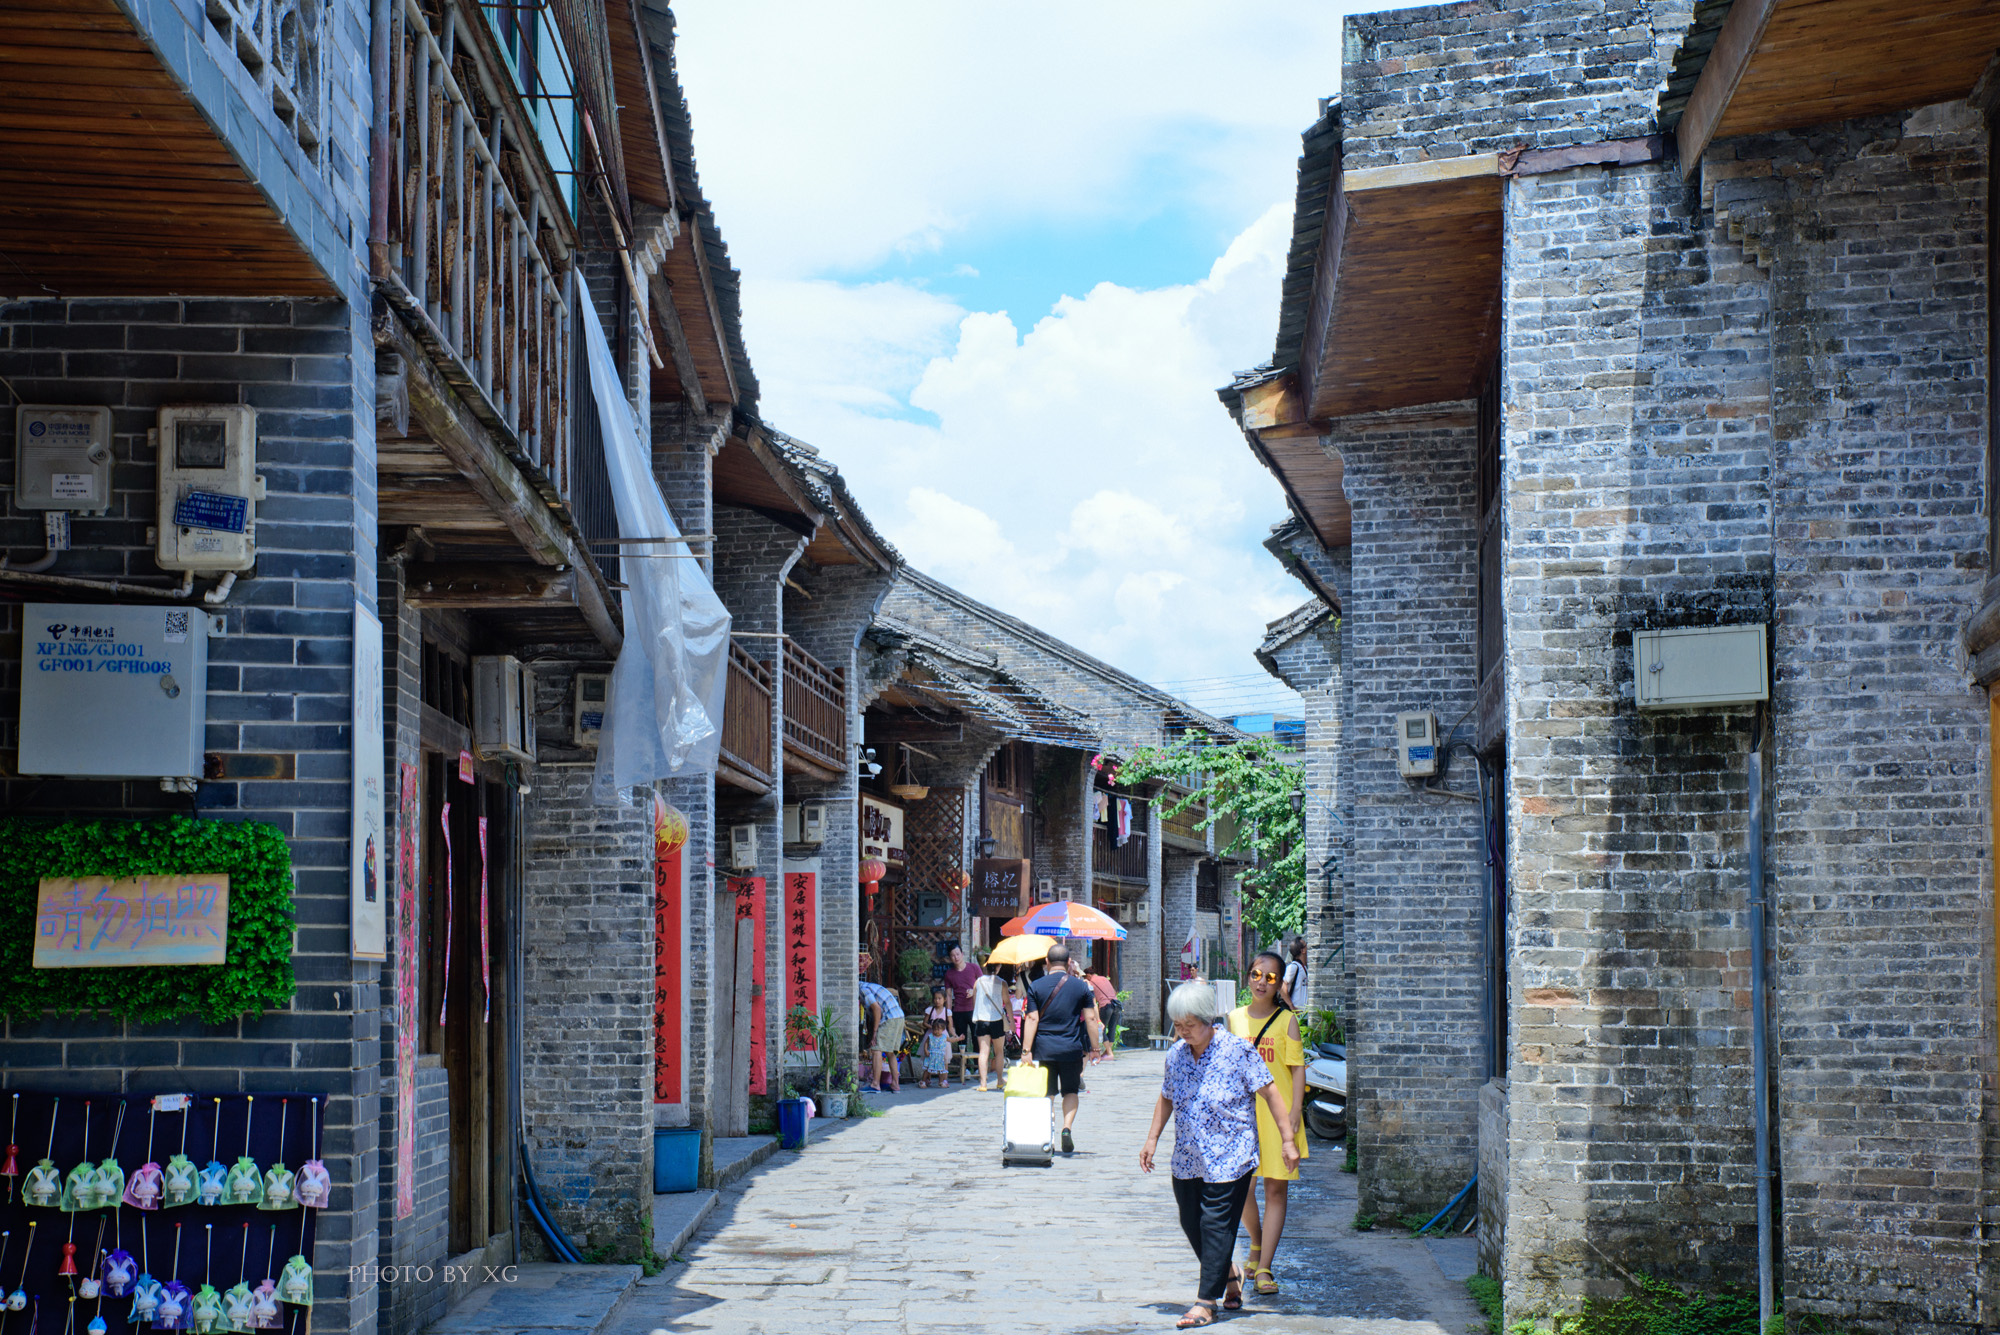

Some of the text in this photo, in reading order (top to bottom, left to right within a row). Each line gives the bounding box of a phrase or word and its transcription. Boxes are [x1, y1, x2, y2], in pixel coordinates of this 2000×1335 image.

[36, 642, 144, 657] XPING/GJ001
[39, 659, 171, 674] GF001/GFH008
[38, 881, 221, 951] 請勿拍照
